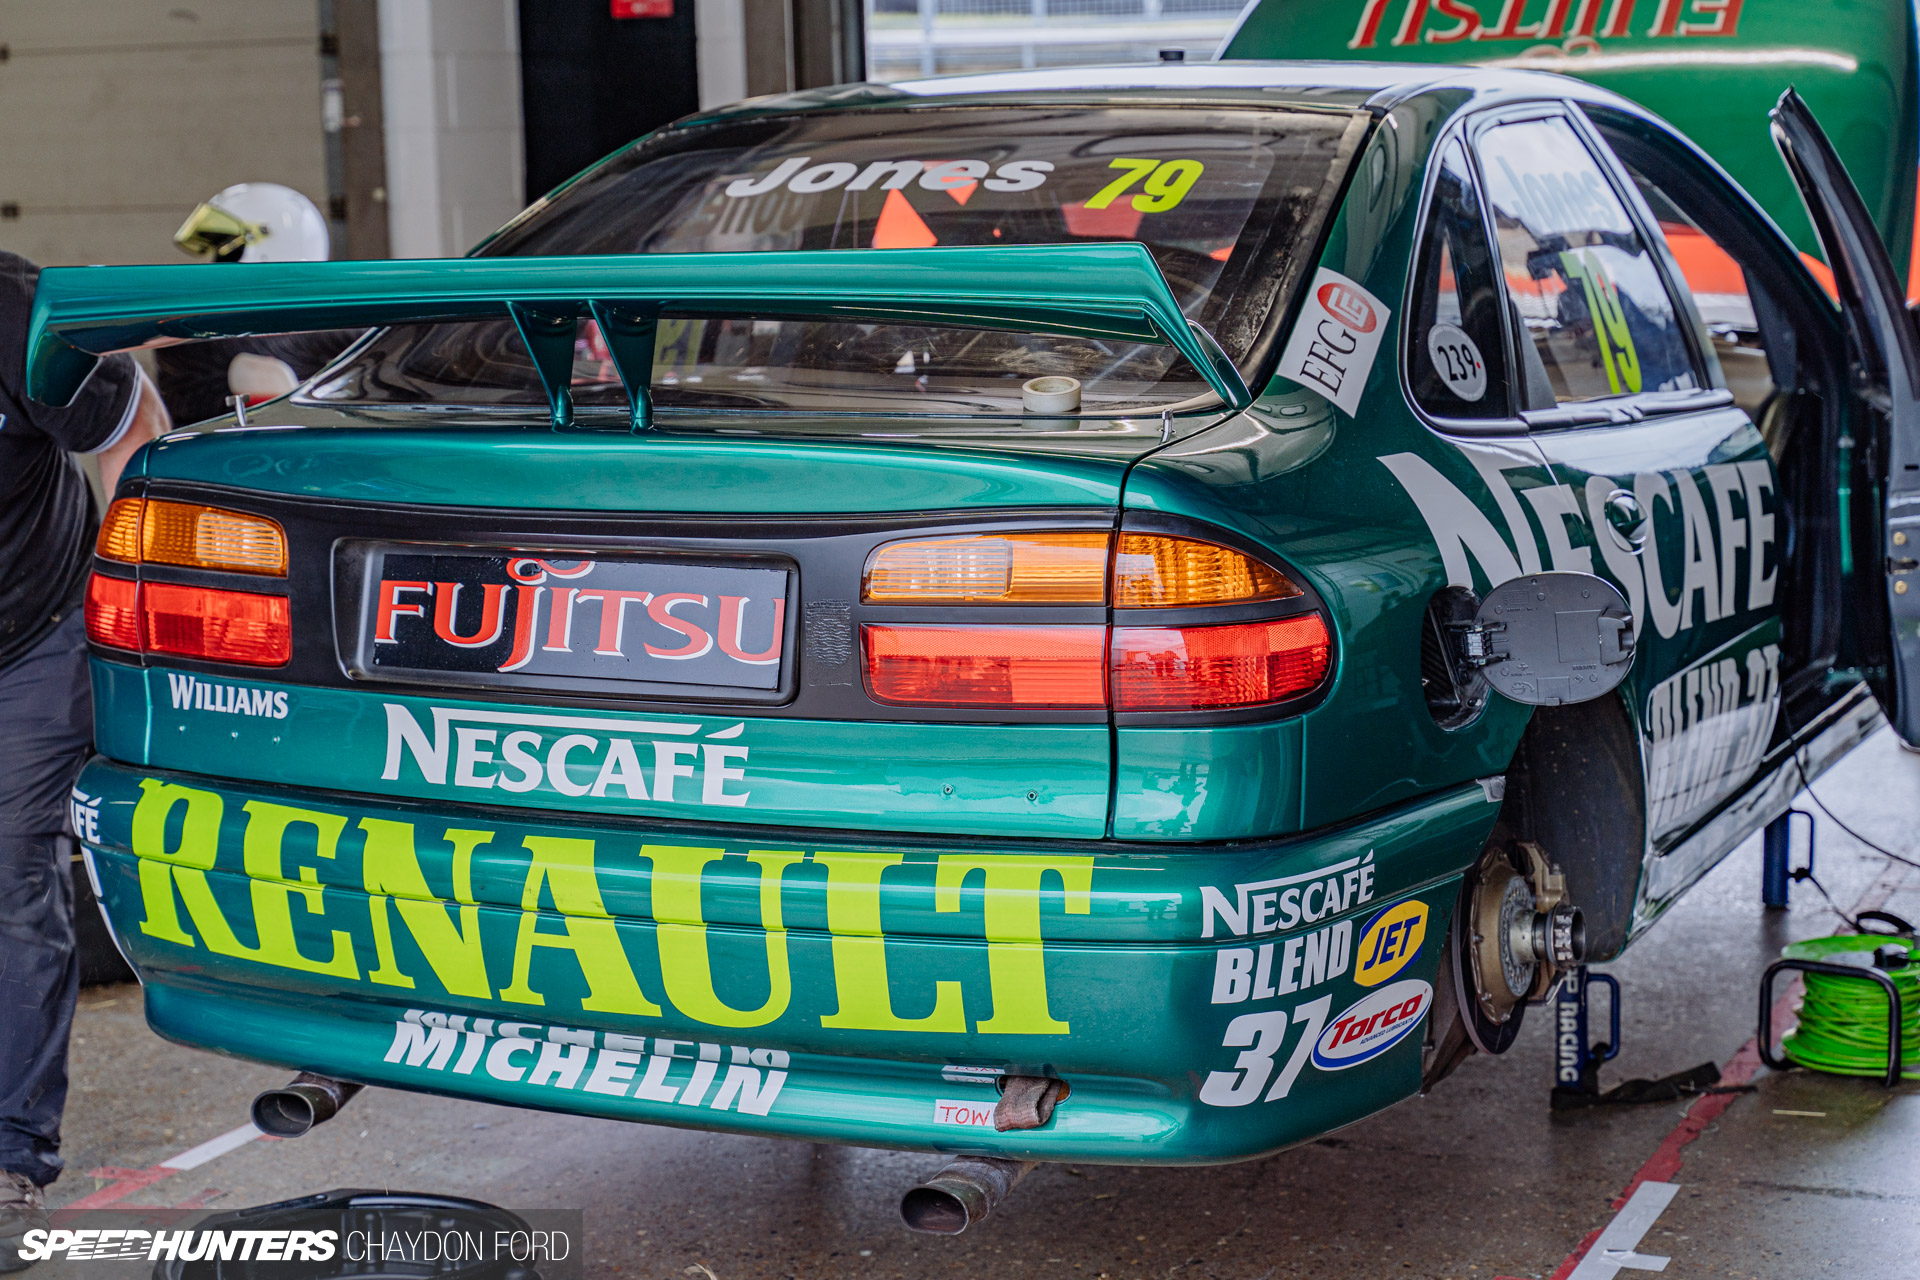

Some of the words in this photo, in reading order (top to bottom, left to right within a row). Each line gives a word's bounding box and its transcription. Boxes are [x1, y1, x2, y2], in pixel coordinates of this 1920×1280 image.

[725, 156, 1055, 197] Jones
[1084, 158, 1204, 213] 79
[1496, 155, 1620, 232] Jones
[1299, 319, 1357, 397] EFG
[1559, 249, 1643, 394] 79
[374, 558, 786, 672] FUJITSU
[168, 673, 289, 719] WILLIAMS
[381, 703, 750, 807] NESCAFÉ
[132, 777, 1095, 1035] RENAULT
[1199, 849, 1375, 938] NESCAFÉ
[1211, 919, 1353, 1004] BLEND
[1363, 914, 1421, 971] JET
[1199, 993, 1333, 1107] 37
[1328, 993, 1424, 1050] Torco
[1560, 1002, 1579, 1082] RACING
[383, 1020, 789, 1116] MICHELIN
[939, 1105, 991, 1127] TOW
